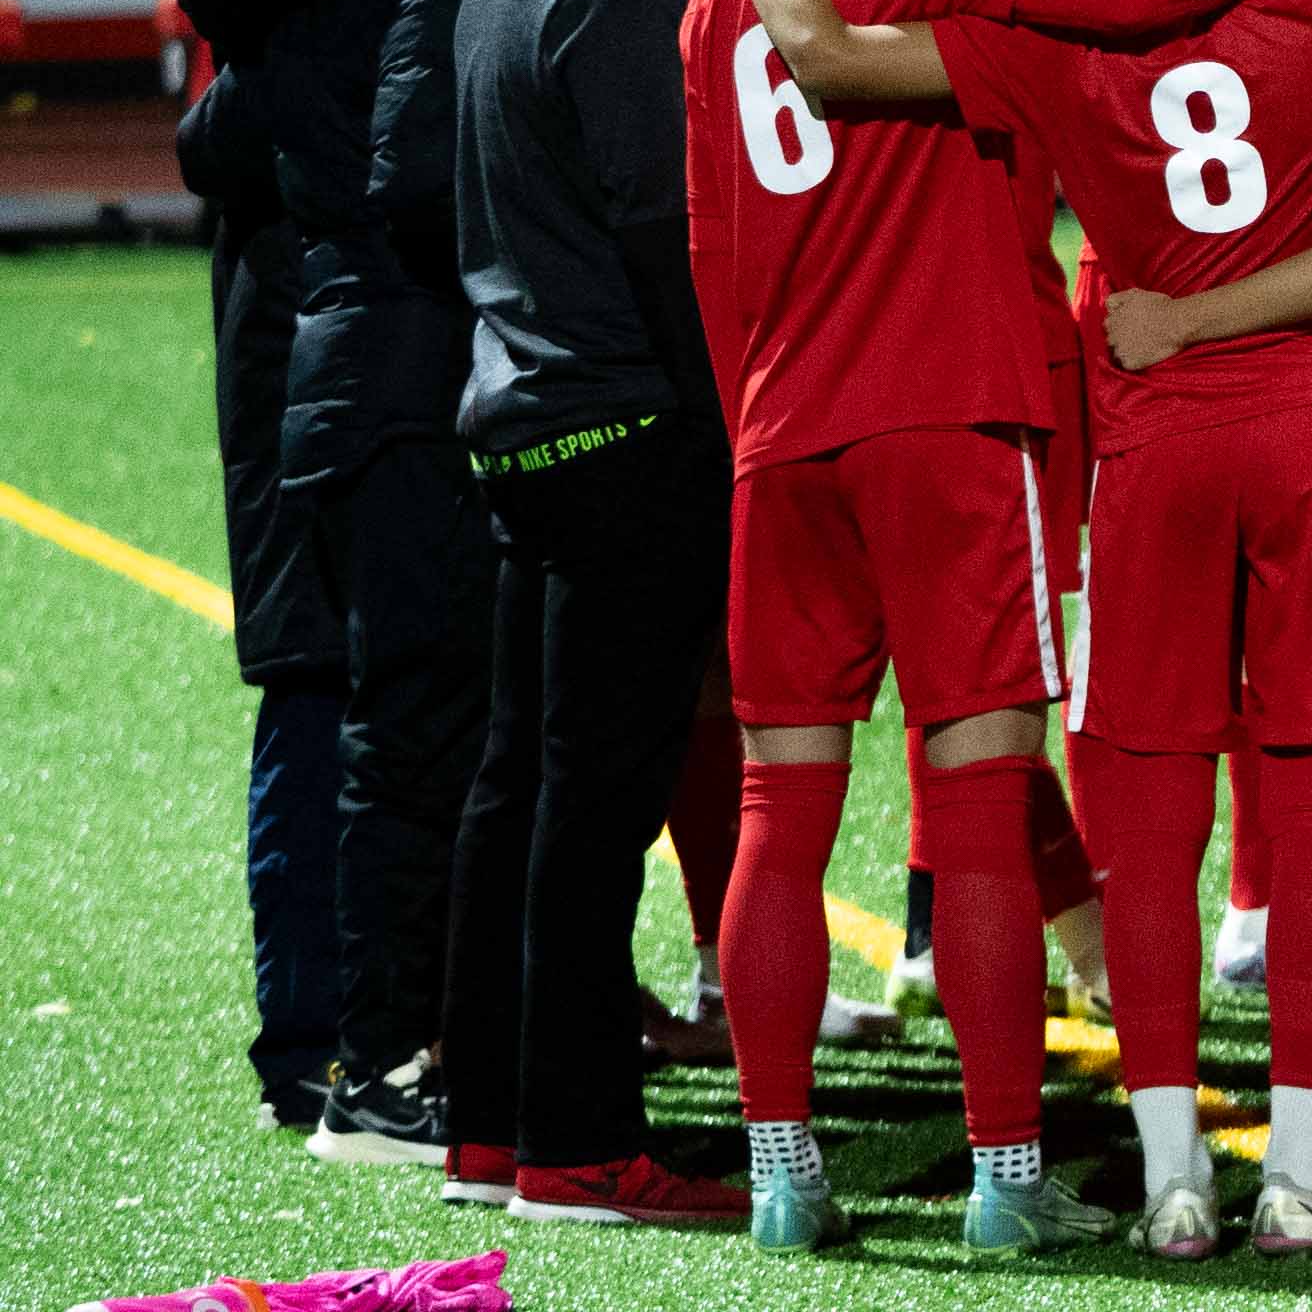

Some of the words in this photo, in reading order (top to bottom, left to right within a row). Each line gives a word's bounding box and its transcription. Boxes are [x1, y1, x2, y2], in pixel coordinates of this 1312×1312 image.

[734, 24, 834, 195] 6
[1150, 61, 1268, 234] 8
[516, 443, 556, 472] NIKE
